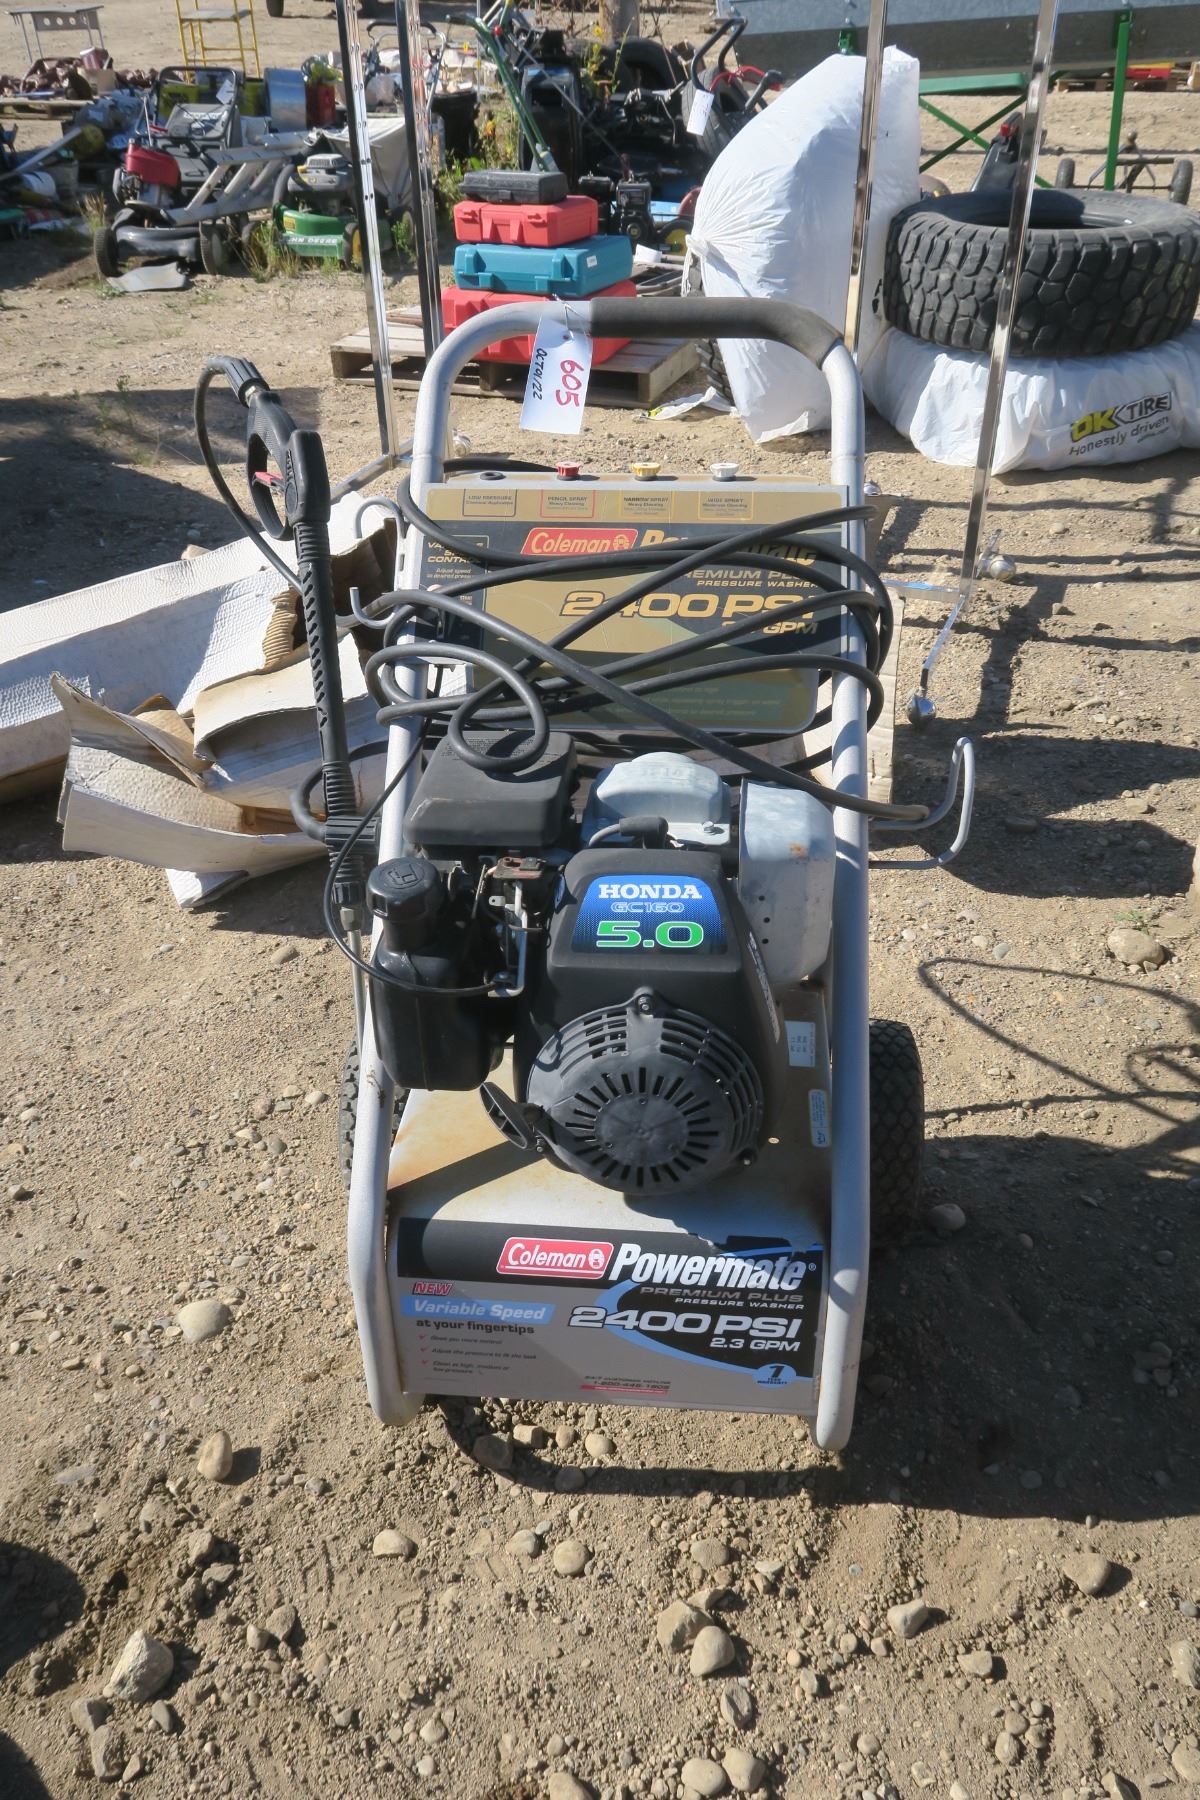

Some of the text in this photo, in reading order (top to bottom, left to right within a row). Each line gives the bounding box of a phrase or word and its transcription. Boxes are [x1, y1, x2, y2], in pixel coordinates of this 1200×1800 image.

[555, 359, 584, 407] 605
[1071, 407, 1120, 443] OK
[1126, 396, 1169, 420] TIRE
[1068, 429, 1127, 456] Honestly
[1130, 415, 1170, 437] driven
[531, 532, 611, 553] Coleman
[697, 580, 763, 589] PRESSURE
[598, 884, 702, 899] HONDA
[611, 902, 685, 913] GC160
[596, 921, 704, 948] 5.0
[508, 1242, 587, 1268] Coleman
[412, 1282, 454, 1296] NEW
[640, 1286, 804, 1303] PREMIUM PLUS
[414, 1299, 547, 1320] Variable Speed
[675, 1298, 744, 1307] PRESSURE
[433, 1321, 465, 1330] your
[467, 1321, 535, 1335] fingertips
[568, 1307, 802, 1339] 2400 PSI
[710, 1338, 801, 1351] 2.3 GPM
[769, 1366, 785, 1377] 1
